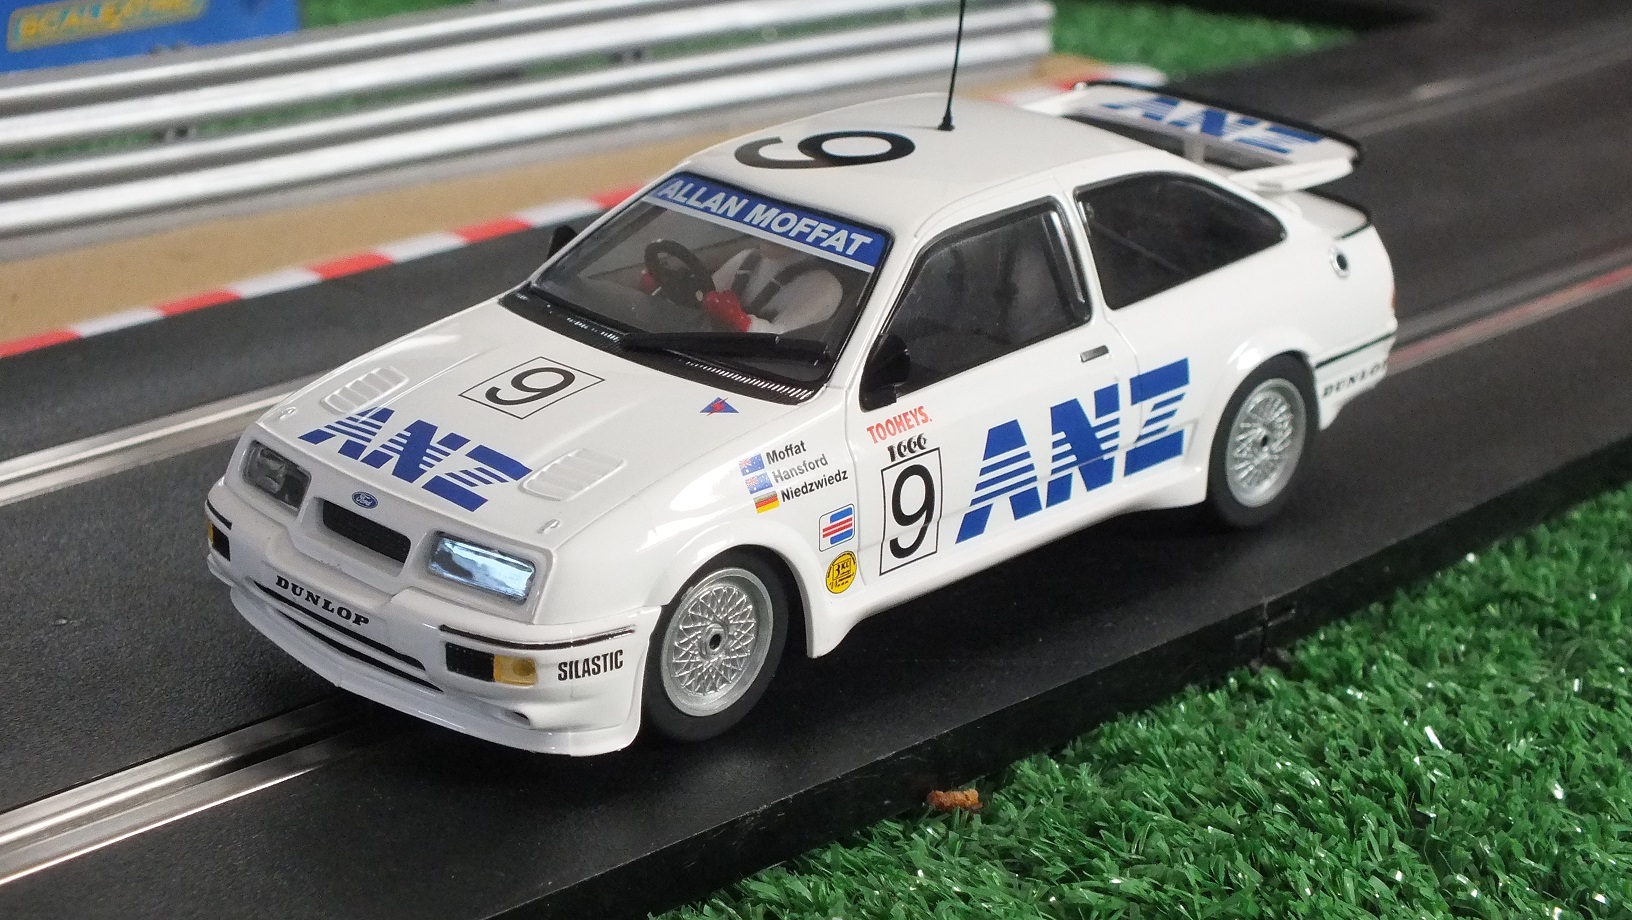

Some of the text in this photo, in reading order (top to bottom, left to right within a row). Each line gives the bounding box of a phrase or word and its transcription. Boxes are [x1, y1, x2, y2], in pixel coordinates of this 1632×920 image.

[657, 179, 873, 256] ALLAN MOFFAT
[485, 367, 576, 406] 9
[297, 407, 533, 512] ANZ
[765, 440, 807, 465] Moffat
[772, 453, 829, 483] Hansford
[955, 357, 1190, 544] ANZ
[780, 469, 849, 502] Niedzwiedz
[889, 464, 936, 559] 9
[275, 575, 370, 626] DUNLOP
[557, 649, 624, 681] SILASTIC
